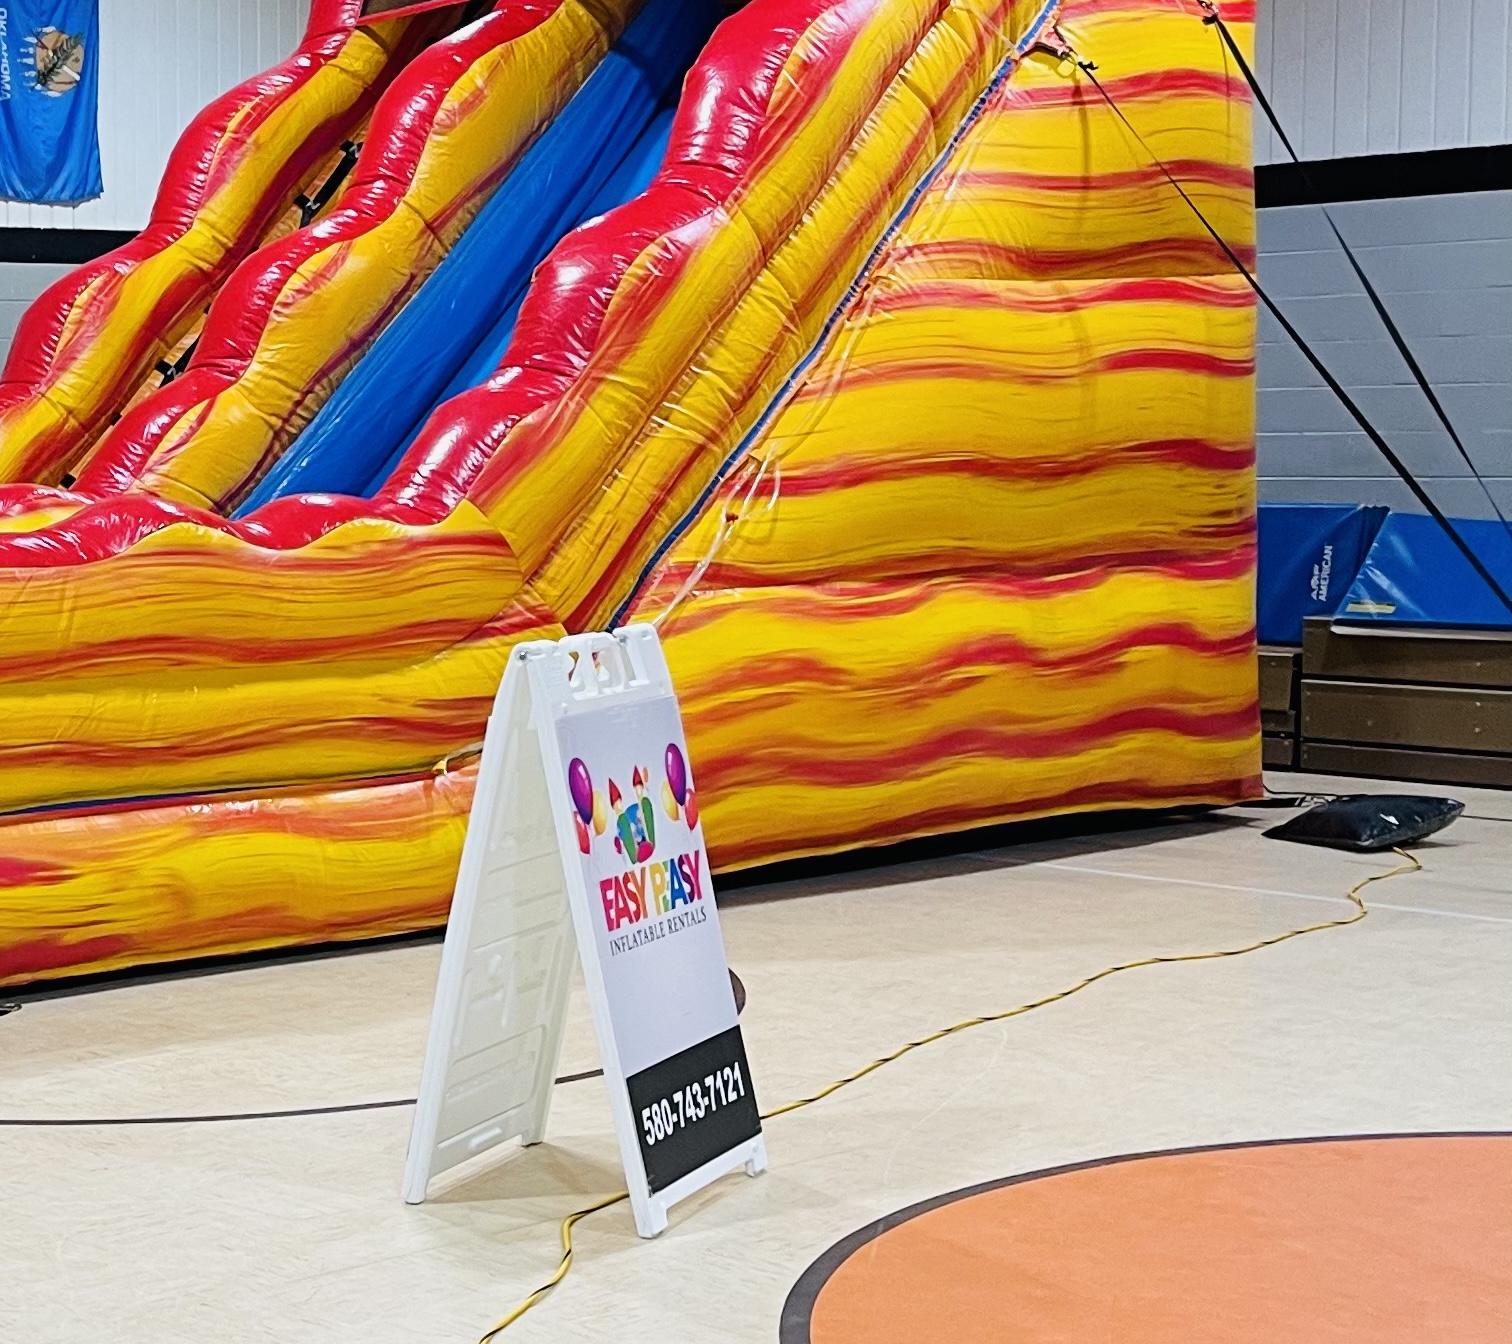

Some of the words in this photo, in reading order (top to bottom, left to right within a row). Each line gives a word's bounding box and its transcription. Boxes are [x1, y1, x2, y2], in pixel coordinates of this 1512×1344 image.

[1318, 545, 1333, 602] AMERICAN
[599, 866, 648, 932] EASY
[649, 849, 702, 916] PEASY
[609, 921, 666, 957] INFLATABLE
[667, 905, 707, 935] RENTALS
[641, 1061, 745, 1146] 580-743-7121
